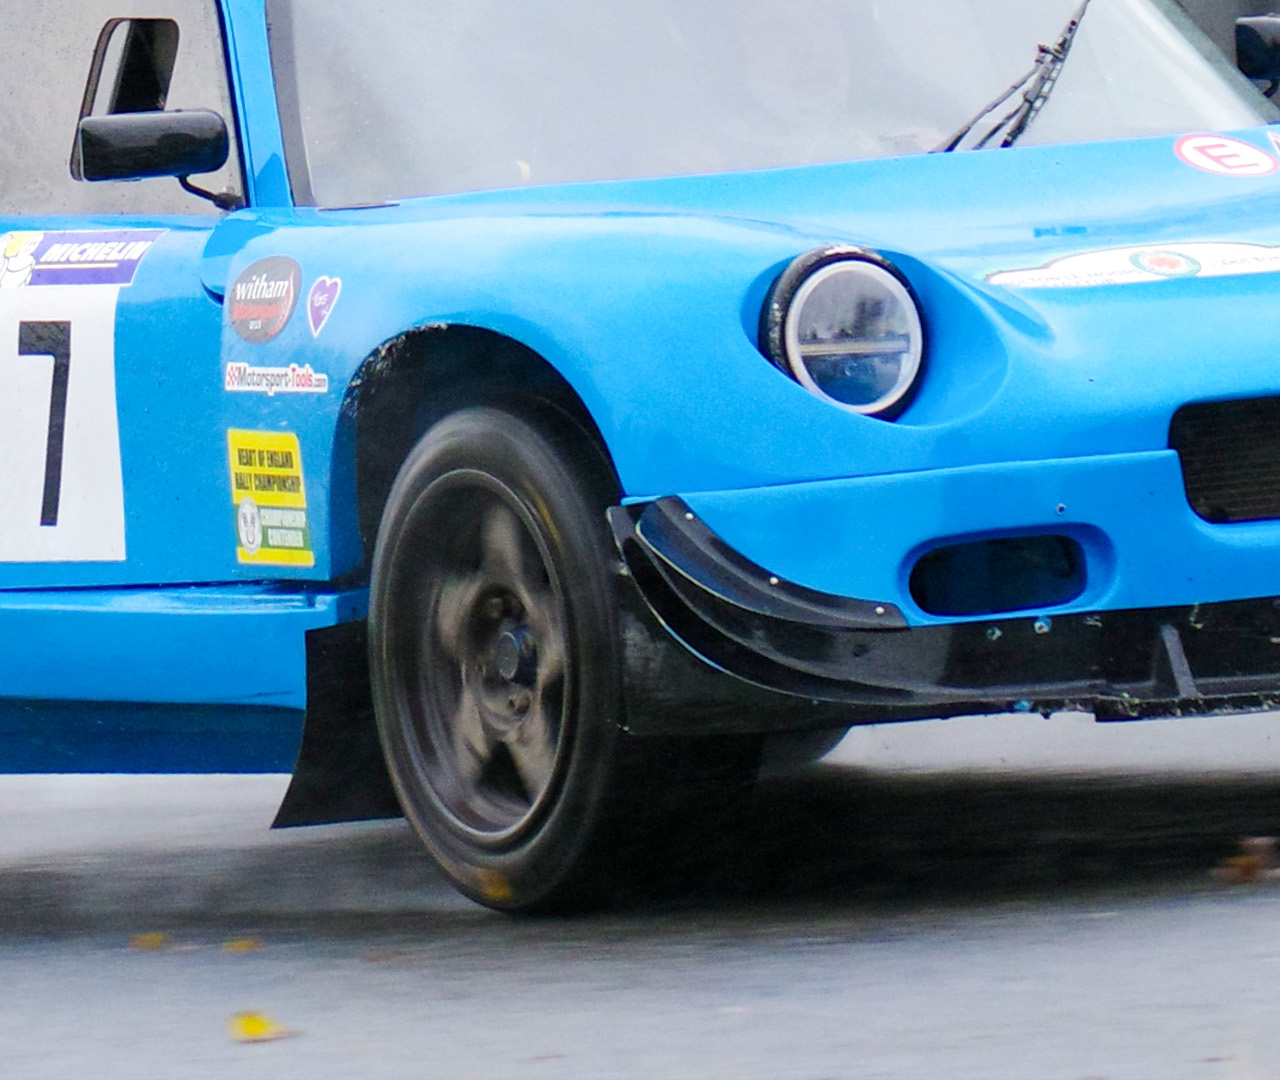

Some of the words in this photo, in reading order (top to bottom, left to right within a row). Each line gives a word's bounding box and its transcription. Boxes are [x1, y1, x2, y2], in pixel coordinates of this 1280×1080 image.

[1192, 143, 1260, 170] E
[40, 241, 154, 262] MICHELIN
[236, 273, 289, 300] witham
[18, 320, 72, 527] 7
[266, 450, 294, 469] ENGLAND
[253, 473, 301, 493] CHAMPIONSHIP
